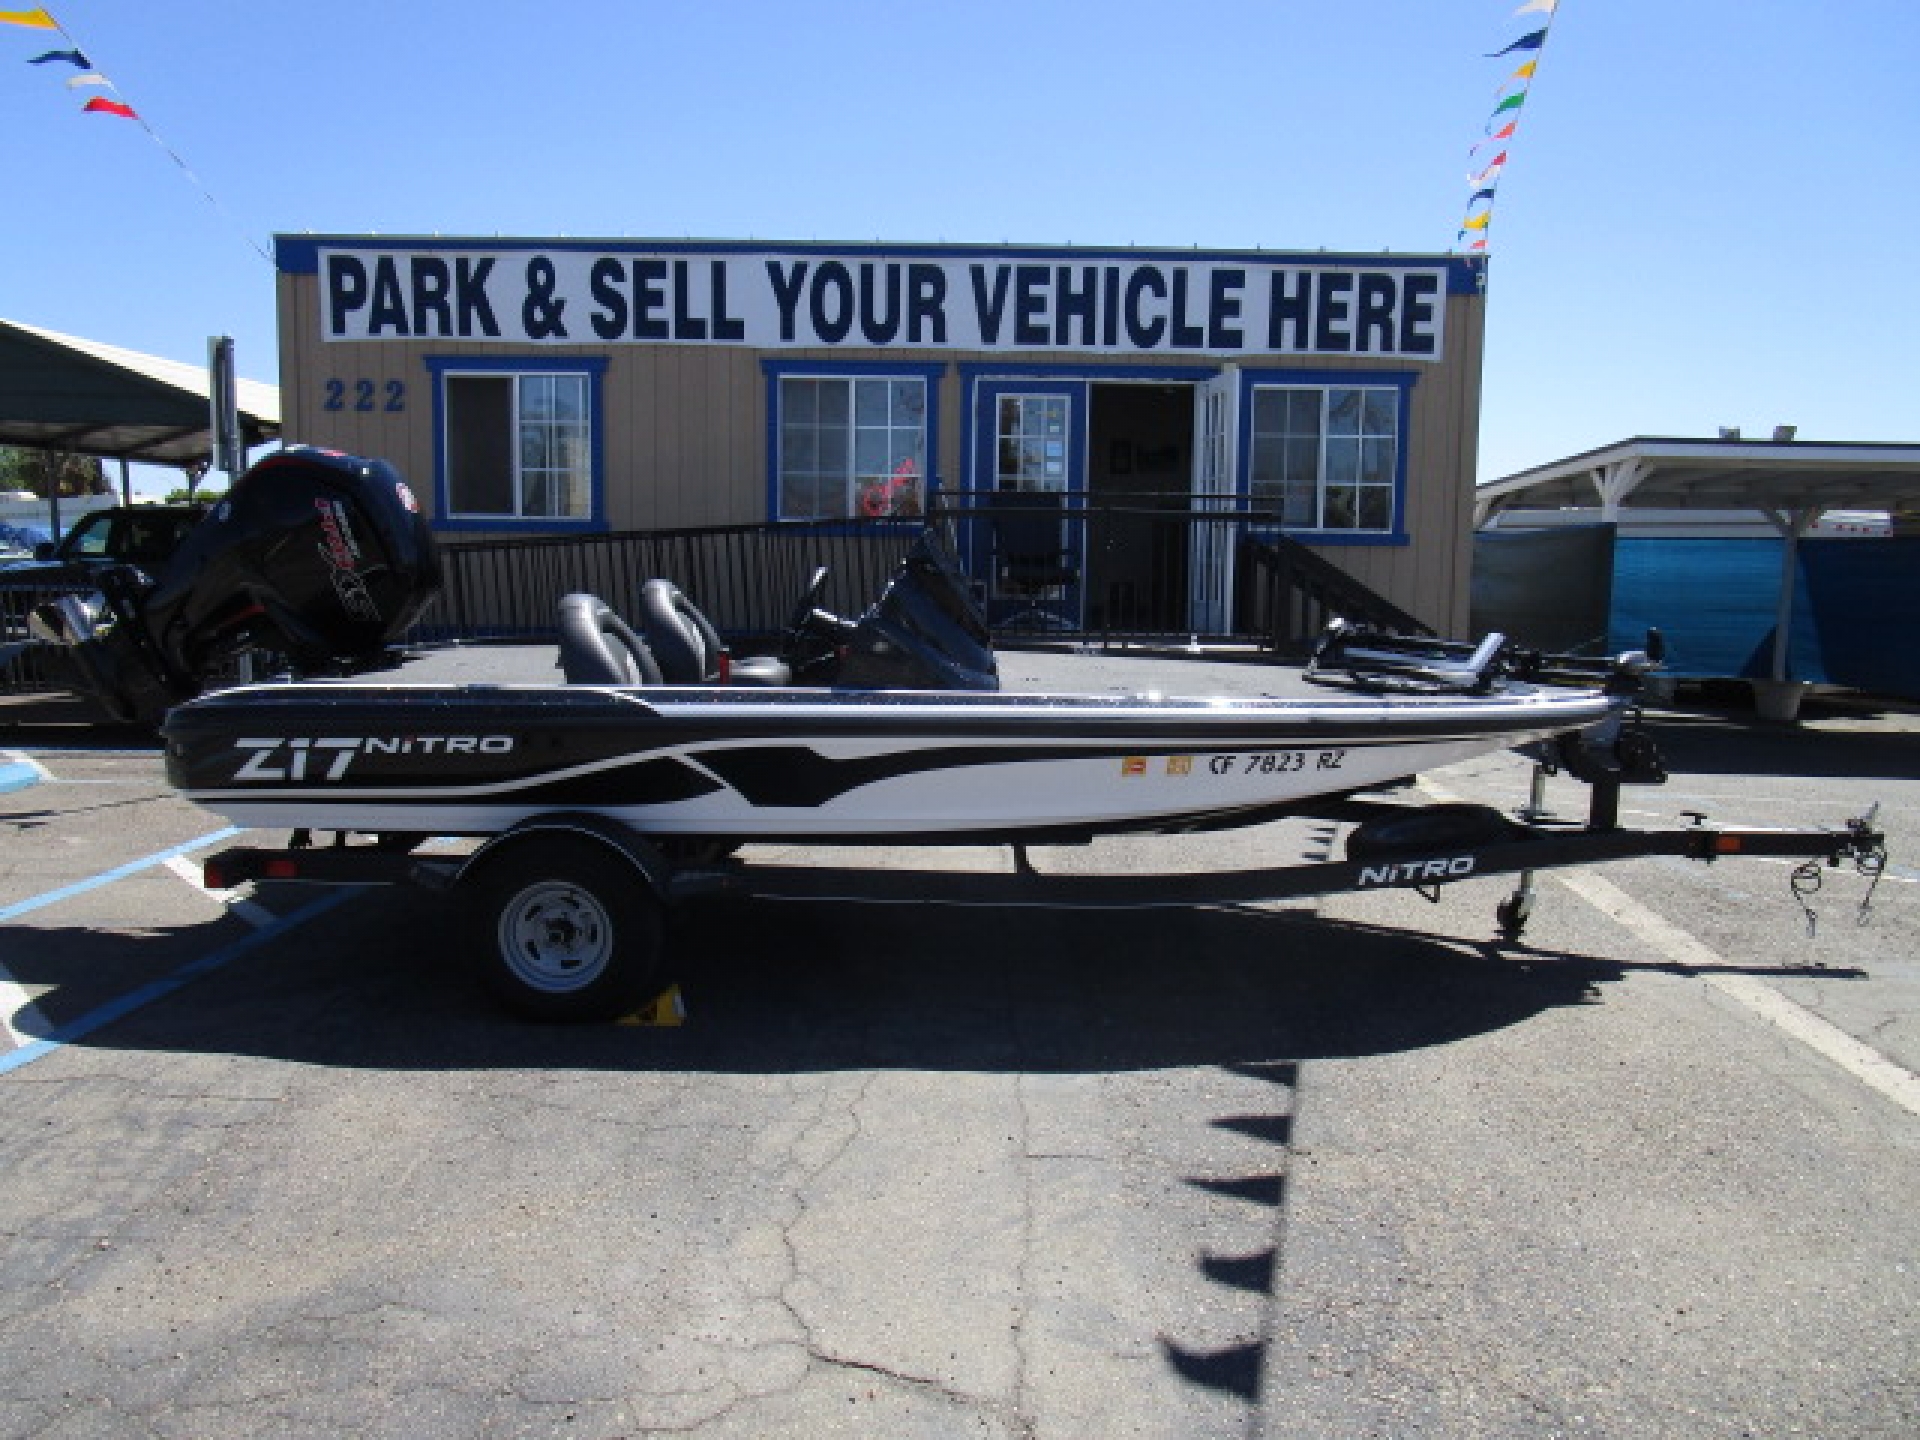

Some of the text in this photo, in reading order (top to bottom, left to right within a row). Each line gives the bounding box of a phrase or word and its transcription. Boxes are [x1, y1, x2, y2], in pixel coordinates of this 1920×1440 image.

[327, 254, 1439, 353] PARK & SELL YOUR VEHICLE HERE
[323, 378, 405, 412] 222
[233, 737, 364, 781] Z17
[1208, 755, 1237, 775] CF
[1244, 752, 1306, 775] 7823
